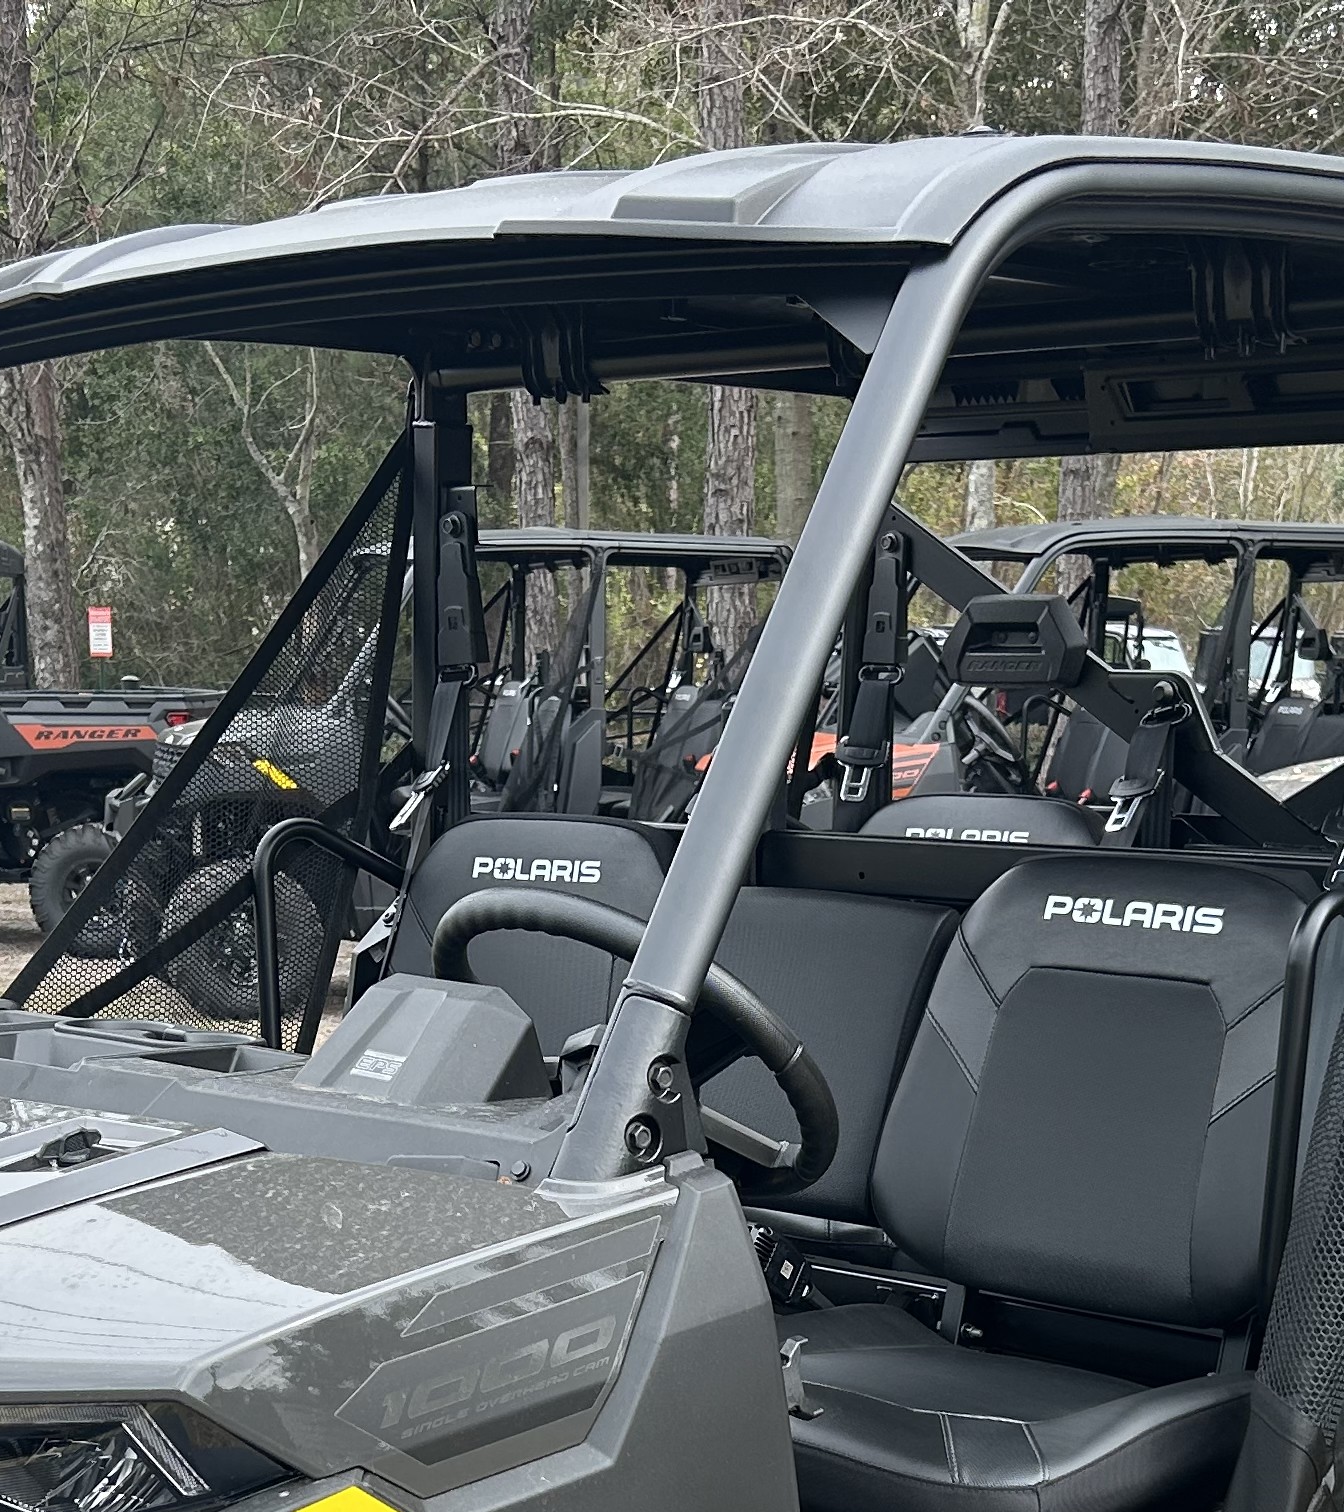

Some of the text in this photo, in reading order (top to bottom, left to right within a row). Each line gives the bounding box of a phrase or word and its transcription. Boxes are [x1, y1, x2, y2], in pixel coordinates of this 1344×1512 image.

[34, 728, 142, 741] RANGER
[472, 856, 602, 883] POLARIS
[1042, 895, 1226, 935] POLARIS
[356, 1056, 403, 1075] EPS
[379, 1315, 617, 1430] 1000
[401, 1409, 469, 1440] SINGLE
[573, 1356, 611, 1378] CAM
